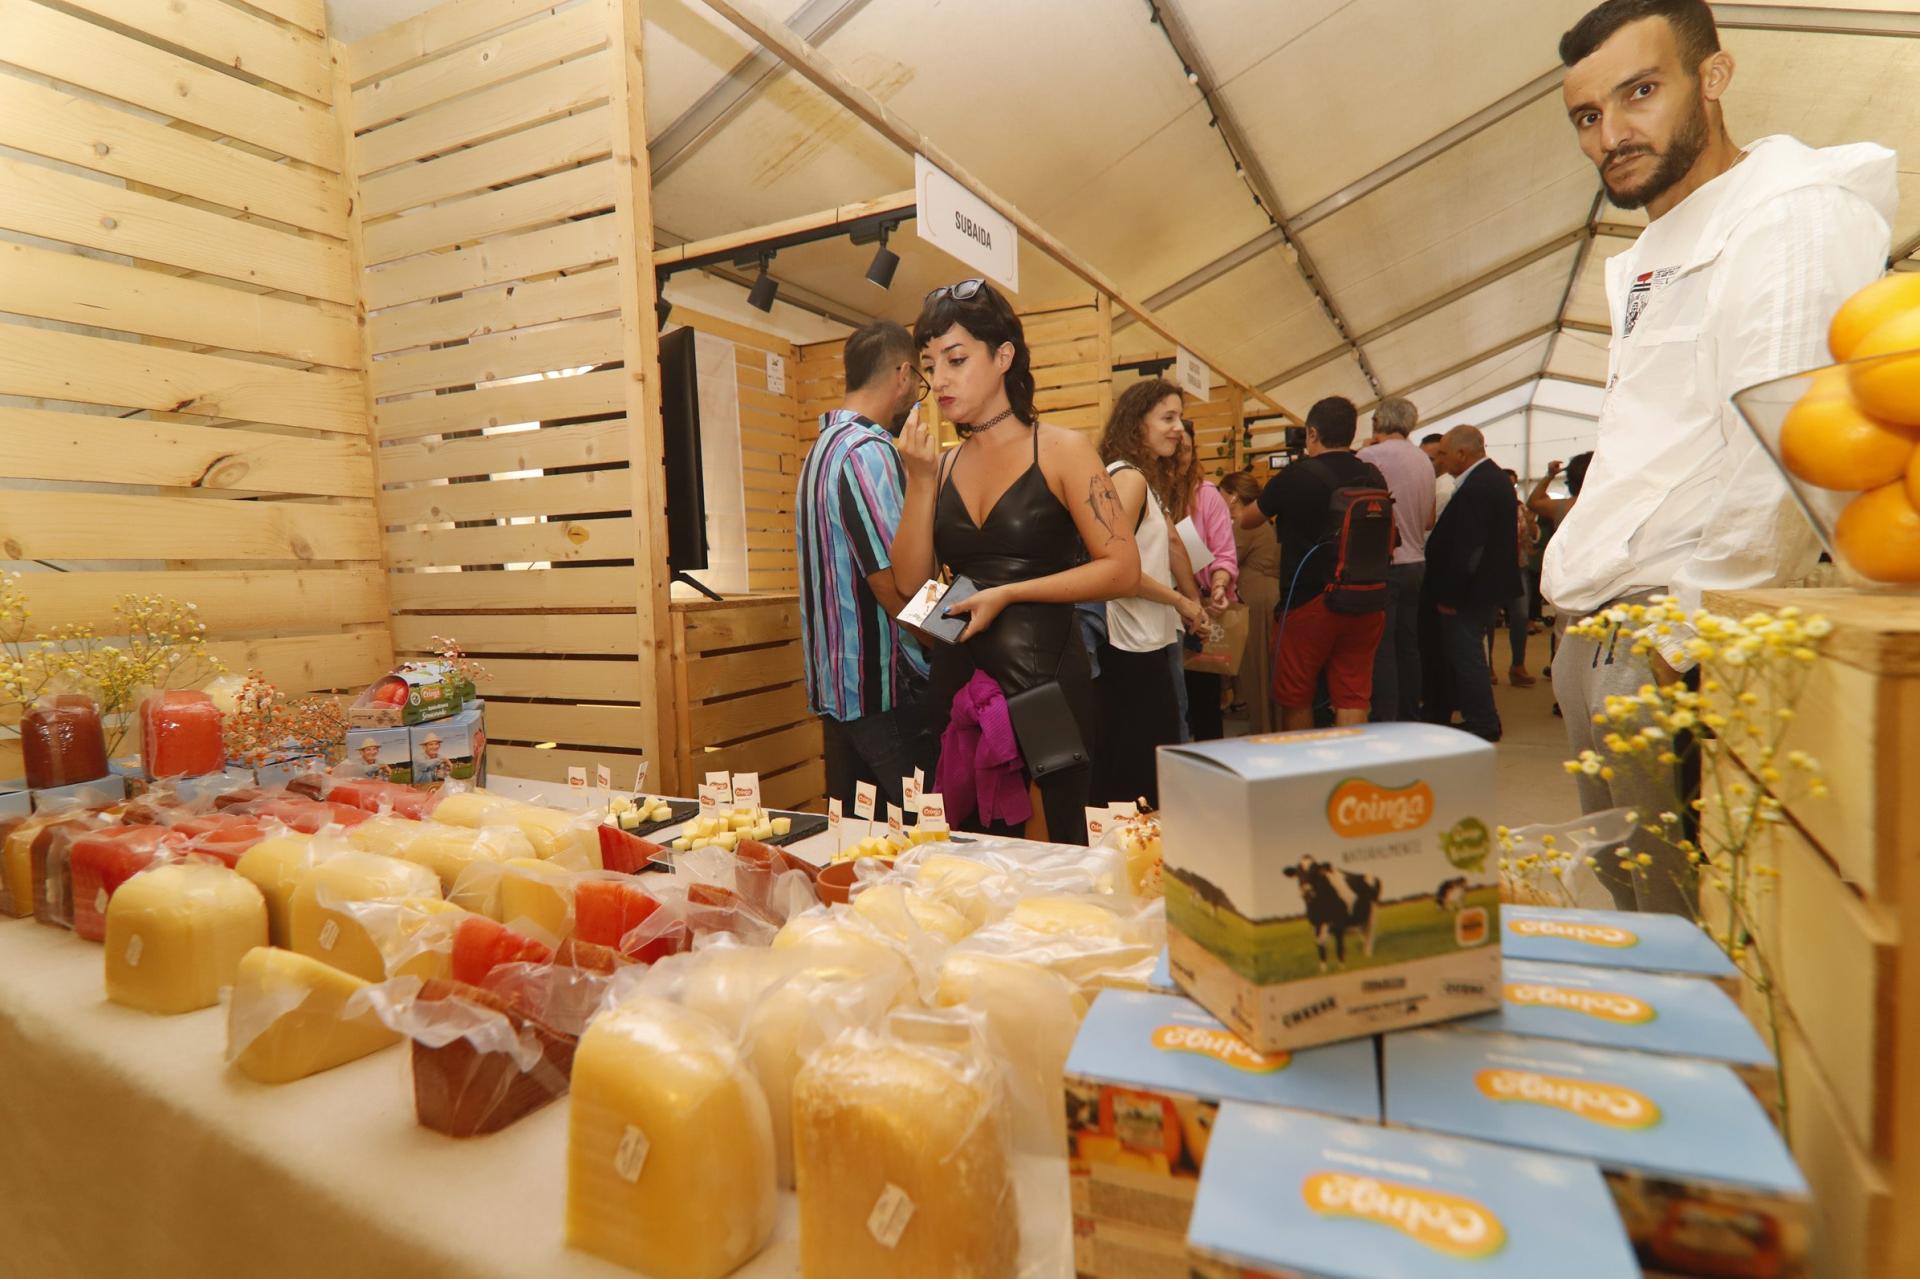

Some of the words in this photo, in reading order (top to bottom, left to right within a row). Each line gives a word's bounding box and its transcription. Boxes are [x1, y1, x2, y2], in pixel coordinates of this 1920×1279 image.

[955, 210, 992, 251] SUBAIDA
[1336, 793, 1425, 830] Coinga
[1491, 1071, 1644, 1119] Coinga
[1319, 1173, 1487, 1243] Coinga
